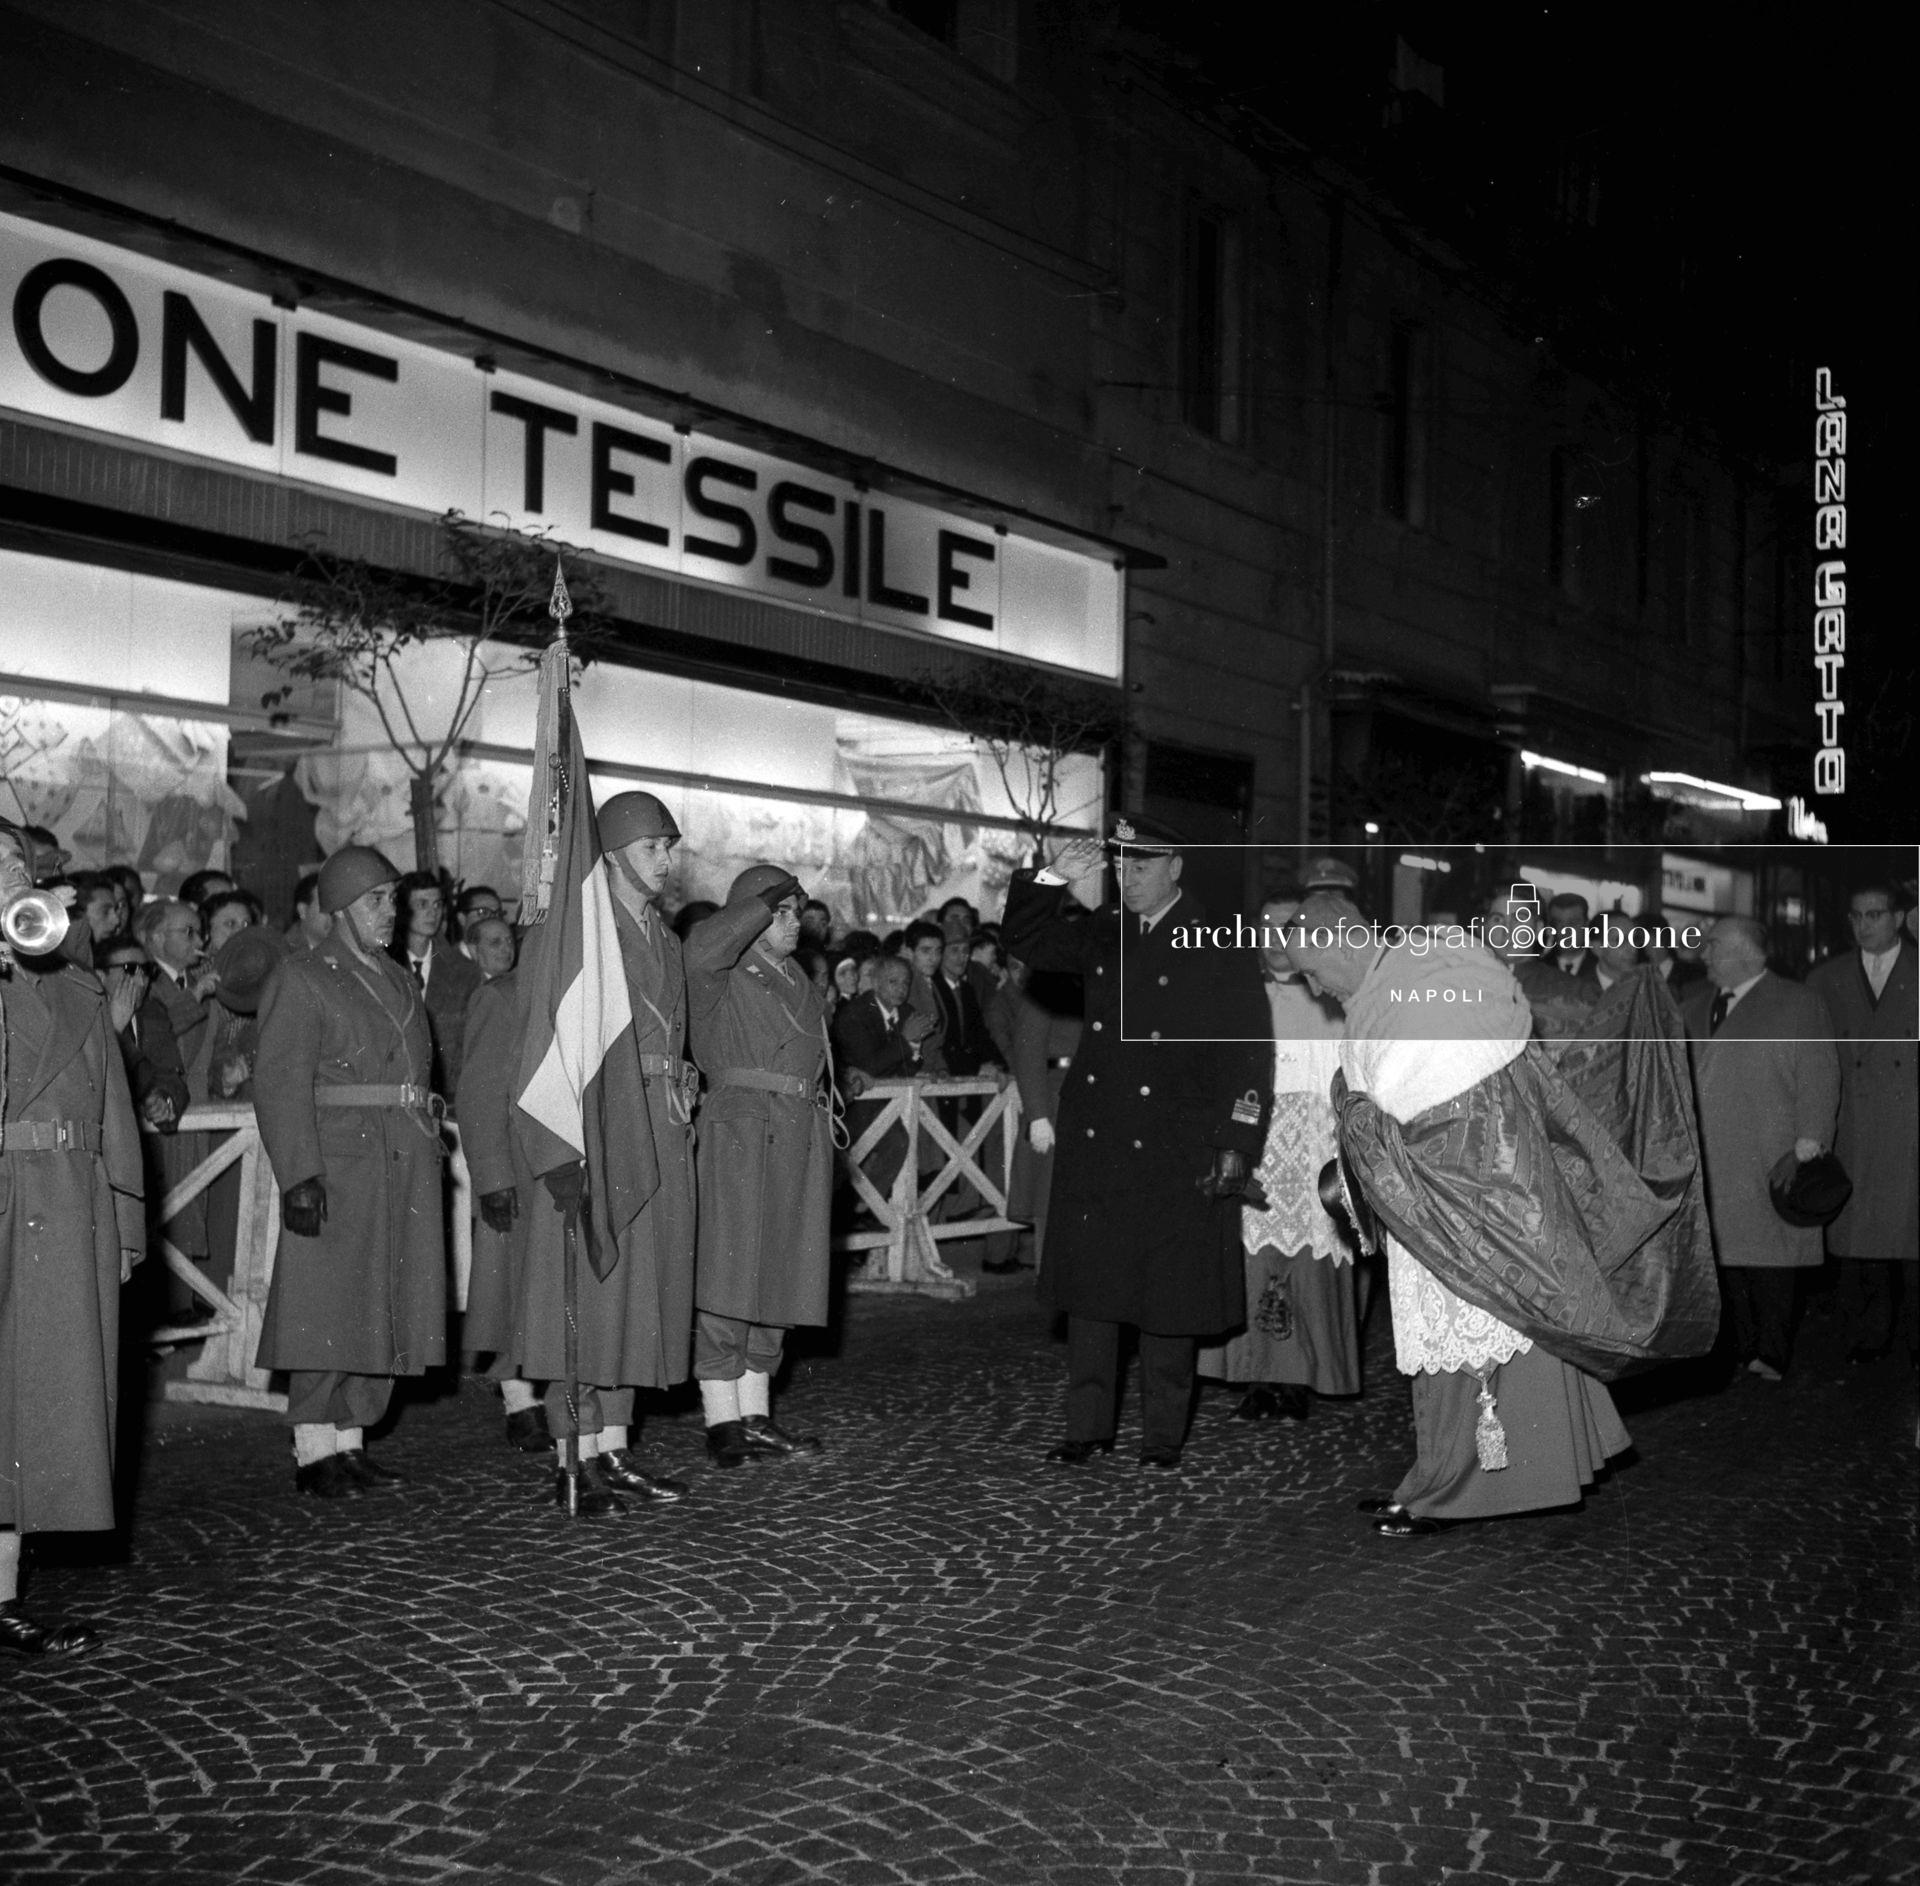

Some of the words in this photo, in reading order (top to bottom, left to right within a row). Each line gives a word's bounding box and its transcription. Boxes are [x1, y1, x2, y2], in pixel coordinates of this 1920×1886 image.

[12, 257, 399, 477] ONE
[490, 390, 996, 631] TESSILE
[1814, 366, 1847, 551] LANA
[1814, 560, 1847, 795] GATTO
